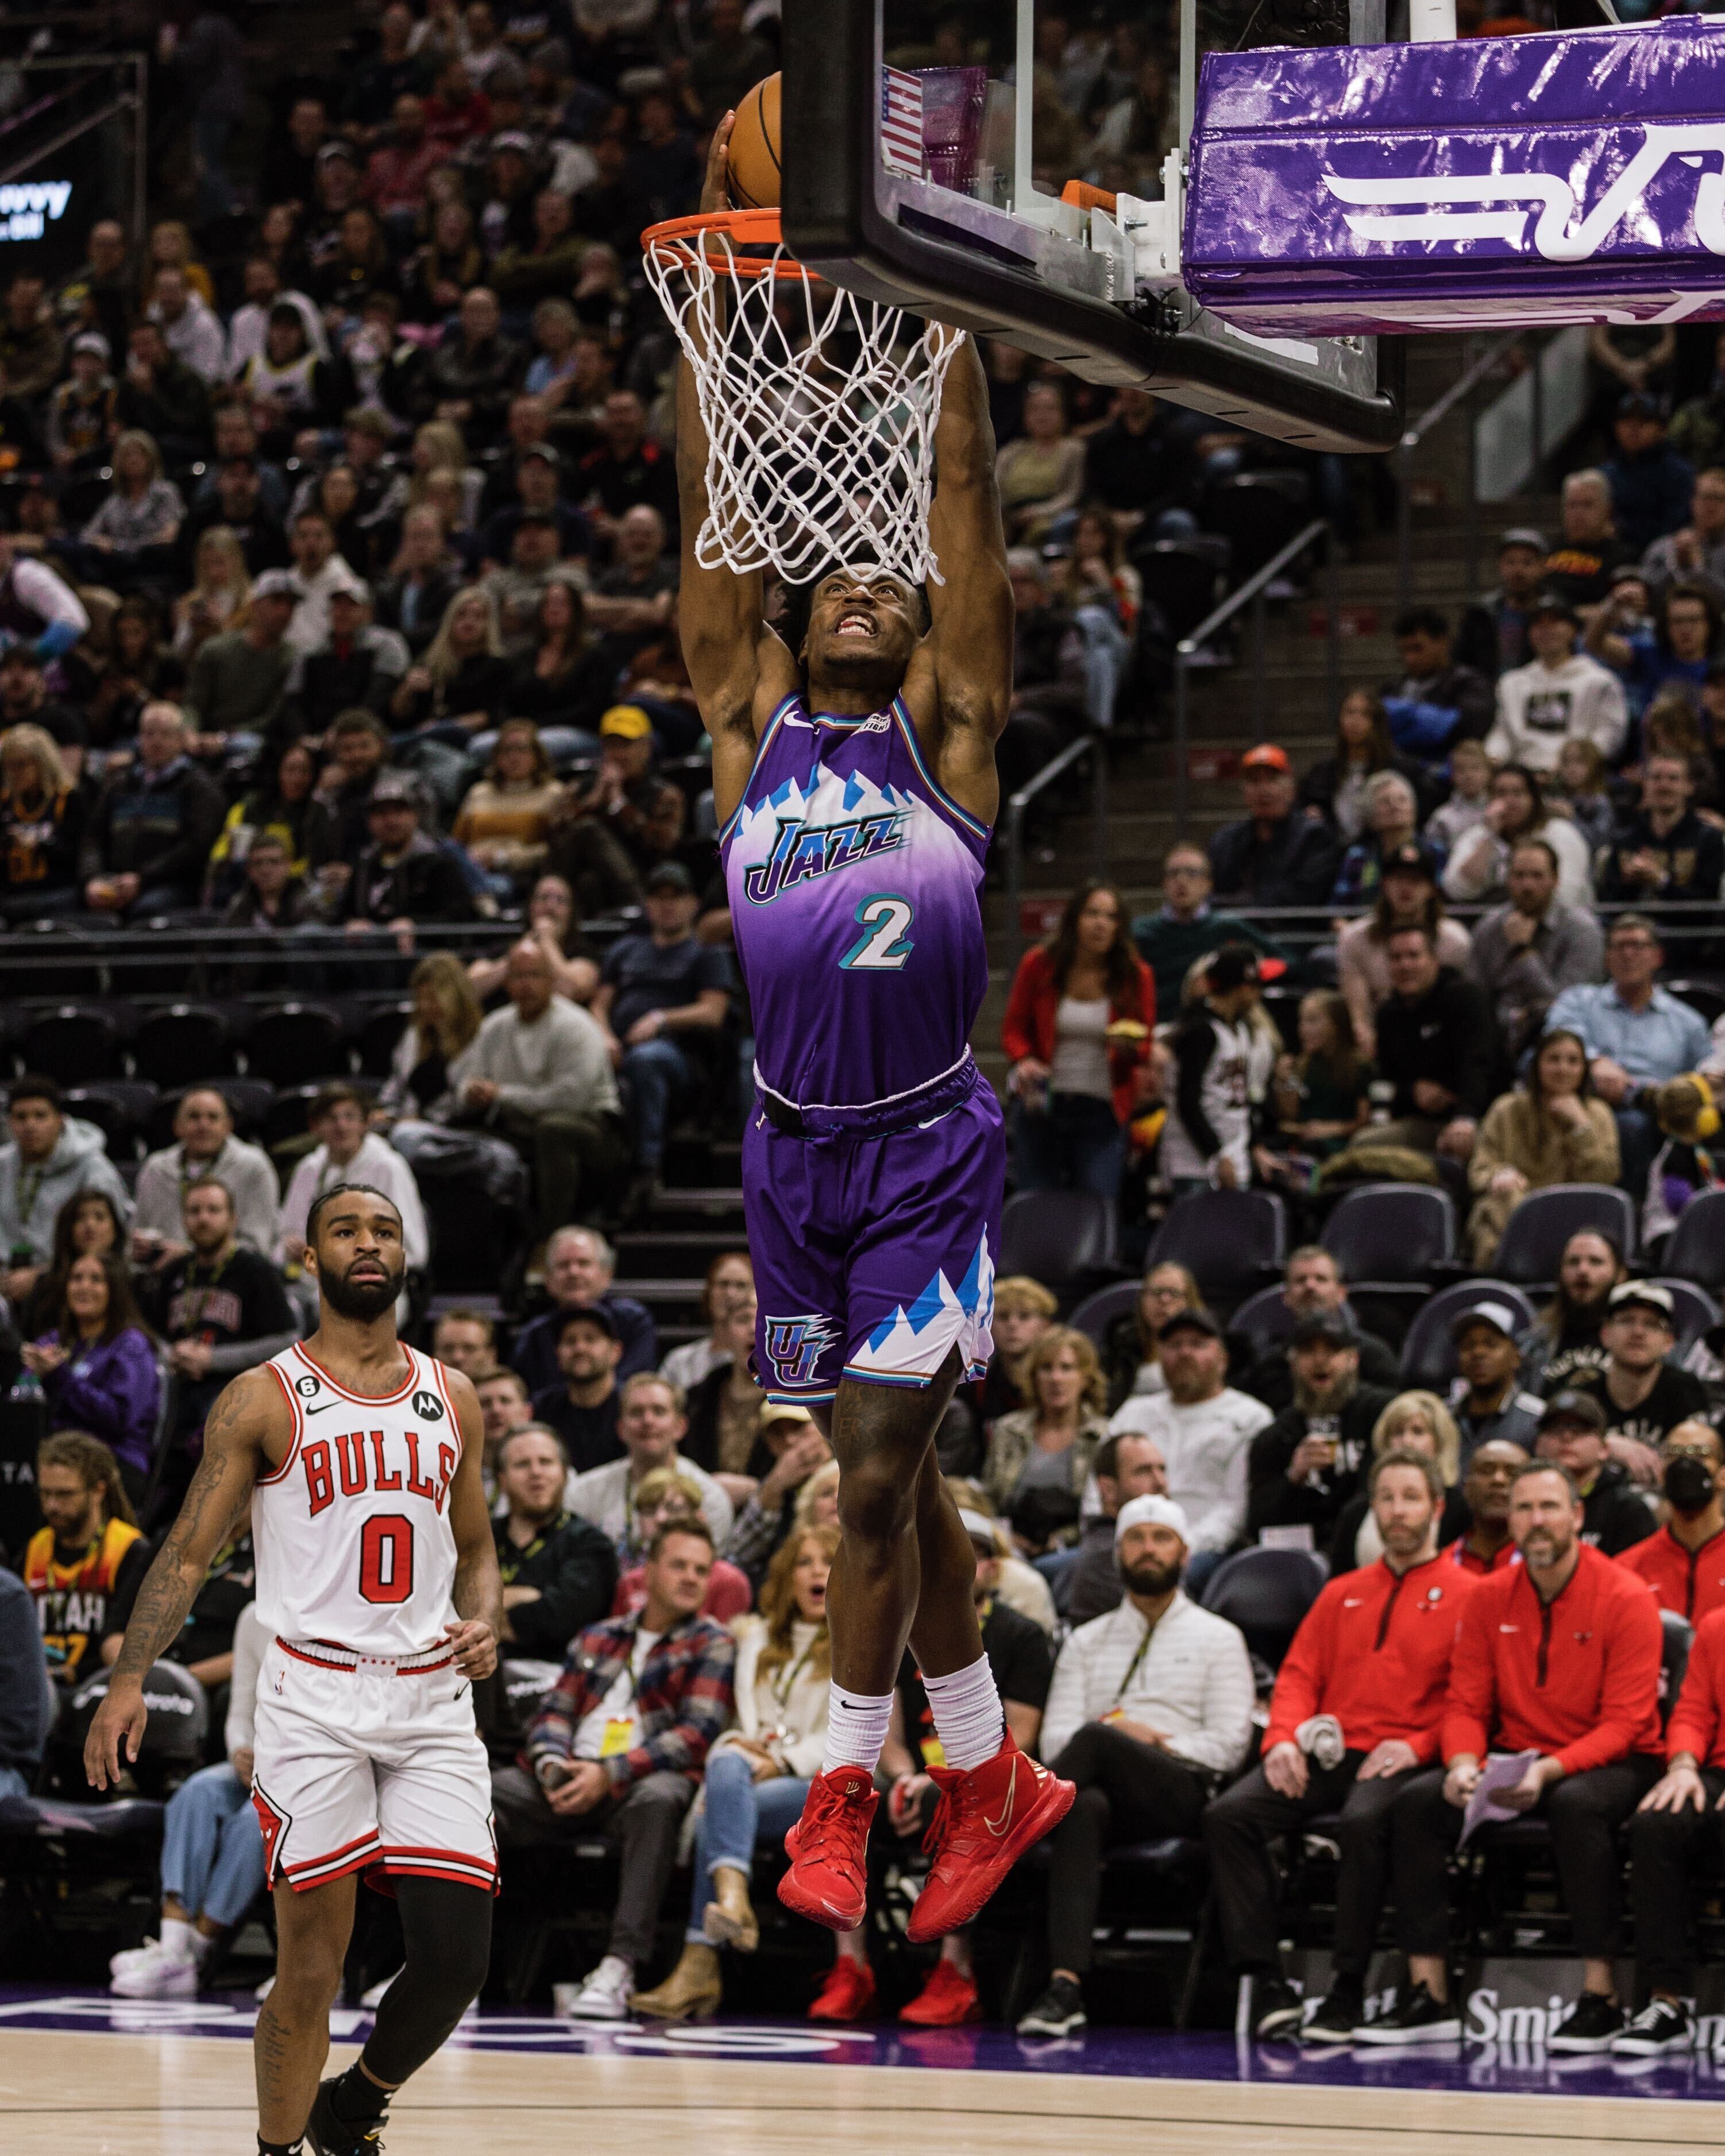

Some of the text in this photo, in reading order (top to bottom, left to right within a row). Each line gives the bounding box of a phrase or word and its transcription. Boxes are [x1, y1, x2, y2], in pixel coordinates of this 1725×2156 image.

[744, 813, 902, 906] JAZZ
[838, 892, 914, 969] 2
[299, 1377, 317, 1397] 6
[300, 1430, 456, 1519] BULLS
[358, 1514, 414, 1604] 0
